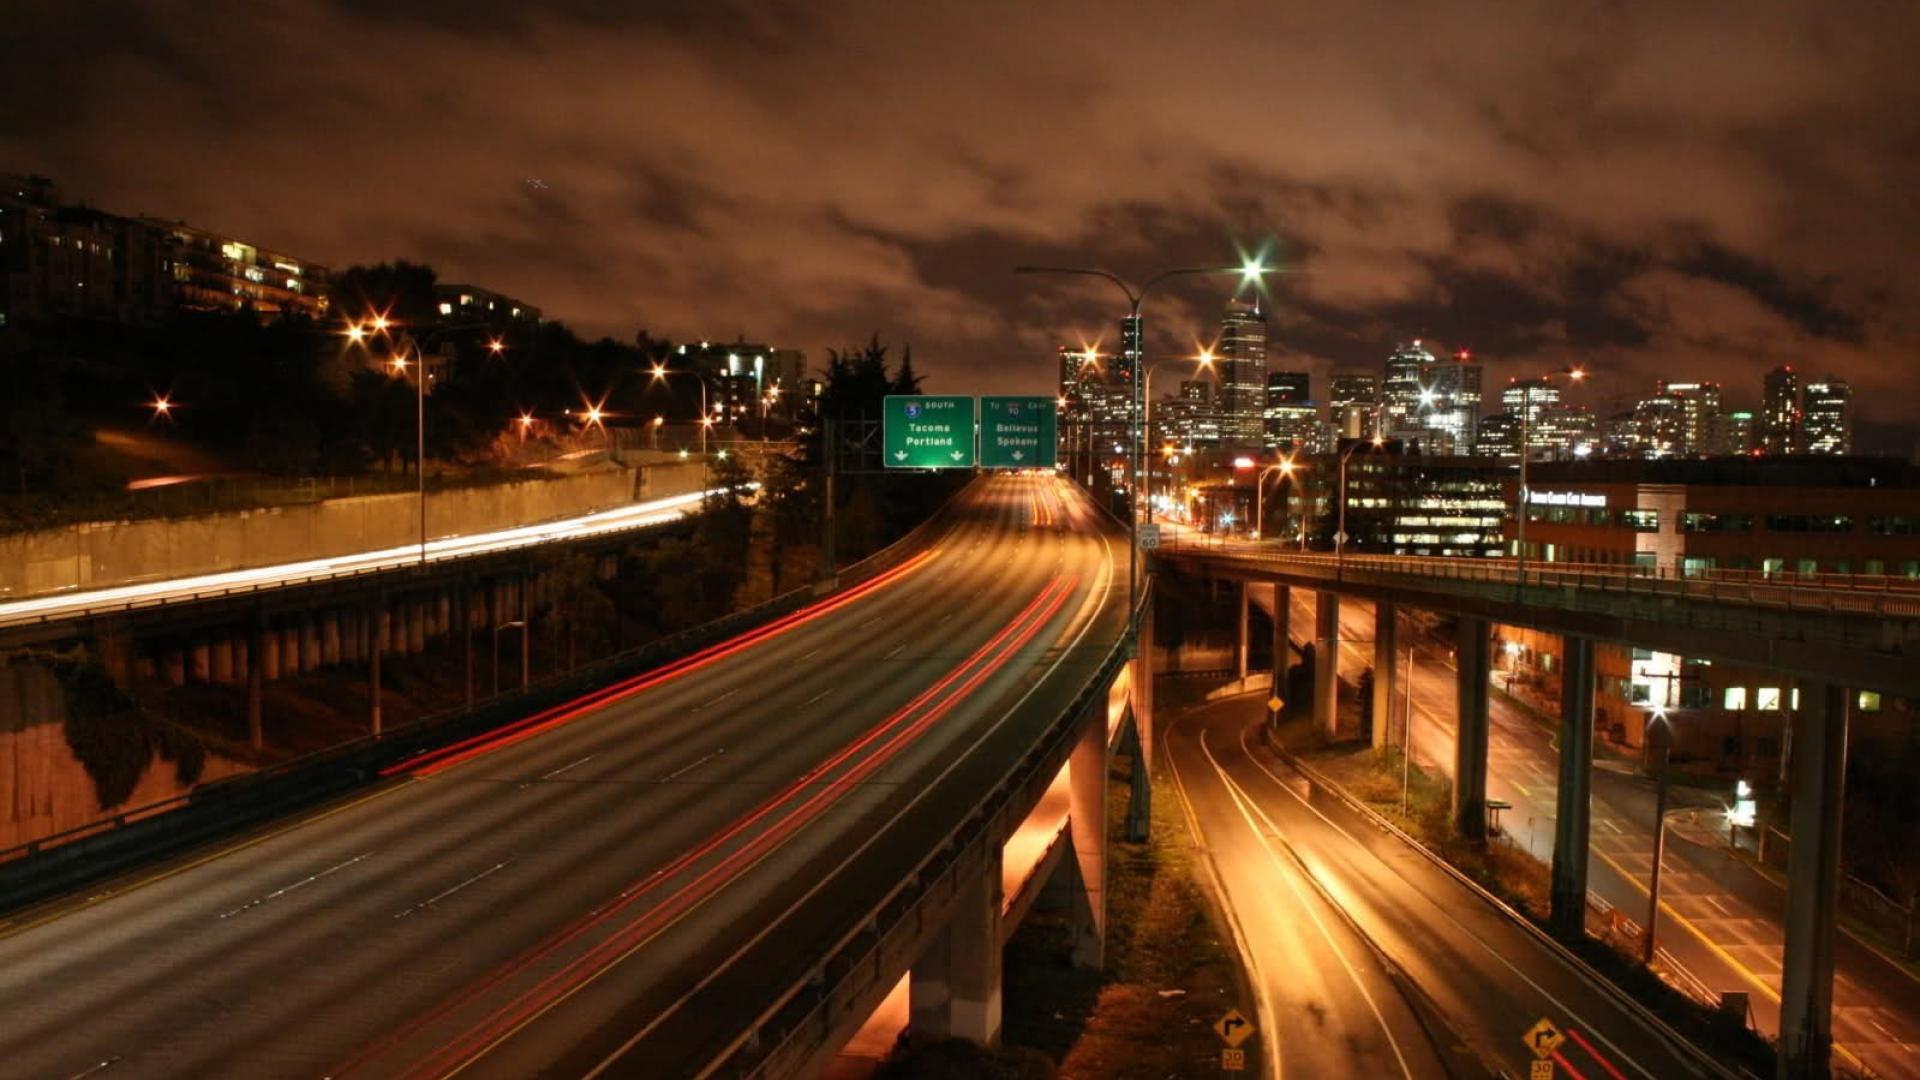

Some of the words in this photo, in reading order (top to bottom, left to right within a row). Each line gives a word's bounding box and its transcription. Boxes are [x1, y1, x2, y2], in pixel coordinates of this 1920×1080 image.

[909, 407, 917, 416] 5
[909, 423, 950, 432] Tacoma
[996, 424, 1038, 432] Bellevue
[906, 437, 952, 446] Portland
[997, 437, 1038, 447] Spokane
[1534, 1063, 1551, 1073] 30
